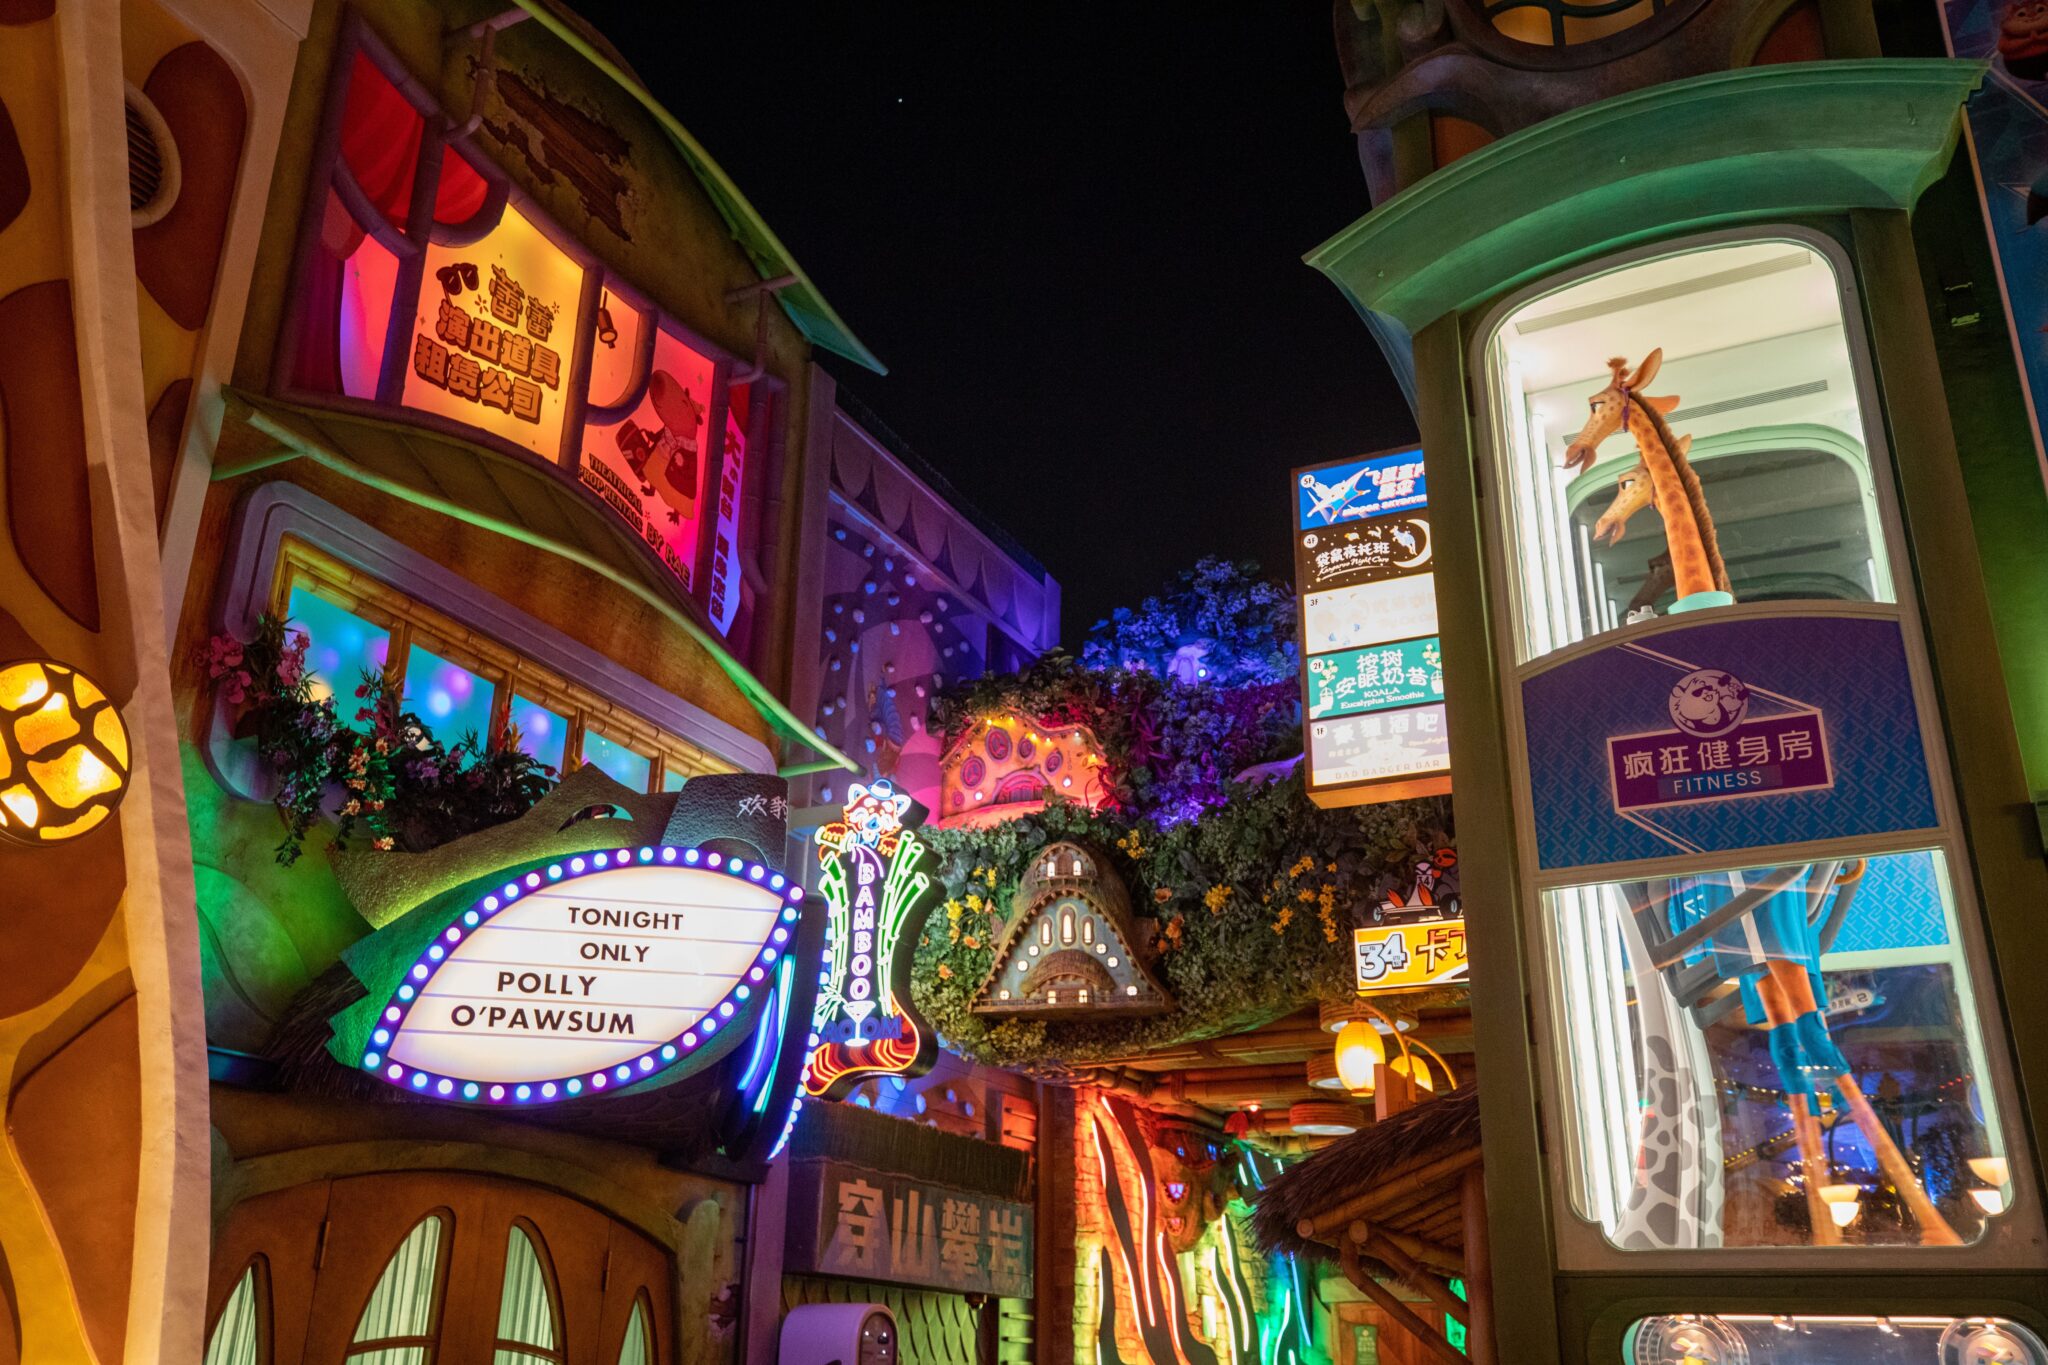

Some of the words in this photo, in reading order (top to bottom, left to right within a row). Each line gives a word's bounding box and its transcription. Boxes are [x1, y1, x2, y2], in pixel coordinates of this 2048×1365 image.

[489, 264, 555, 342] 蕾蕾
[436, 299, 561, 391] 演出道具
[414, 333, 543, 425] 租赁公司
[589, 453, 643, 517] THEATRICAL
[1303, 476, 1313, 485] 5F
[604, 485, 643, 533] RENTALS
[1306, 537, 1316, 545] 4F
[646, 522, 664, 552] BY
[665, 543, 691, 590] RAE
[1310, 599, 1319, 607] 3F
[1313, 662, 1322, 670] 2F
[1357, 649, 1403, 673] 桉树
[1335, 666, 1429, 699] 安眠奶昔
[1363, 687, 1400, 698] KOALA
[1340, 698, 1385, 710] Eucalyptus
[1386, 691, 1425, 703] Smoothie
[1316, 727, 1324, 736] 1F
[1622, 730, 1813, 780] 疯狂健身房
[1673, 770, 1762, 795] FITNESS
[568, 906, 684, 930] TONIGHT
[850, 862, 875, 1001] BAMBOO
[580, 942, 650, 963] ONLY
[1359, 933, 1408, 980] 34
[497, 971, 597, 996] POLLY
[450, 1004, 635, 1035] O'PAWSUM
[838, 1178, 1023, 1288] 穿山攀岩
